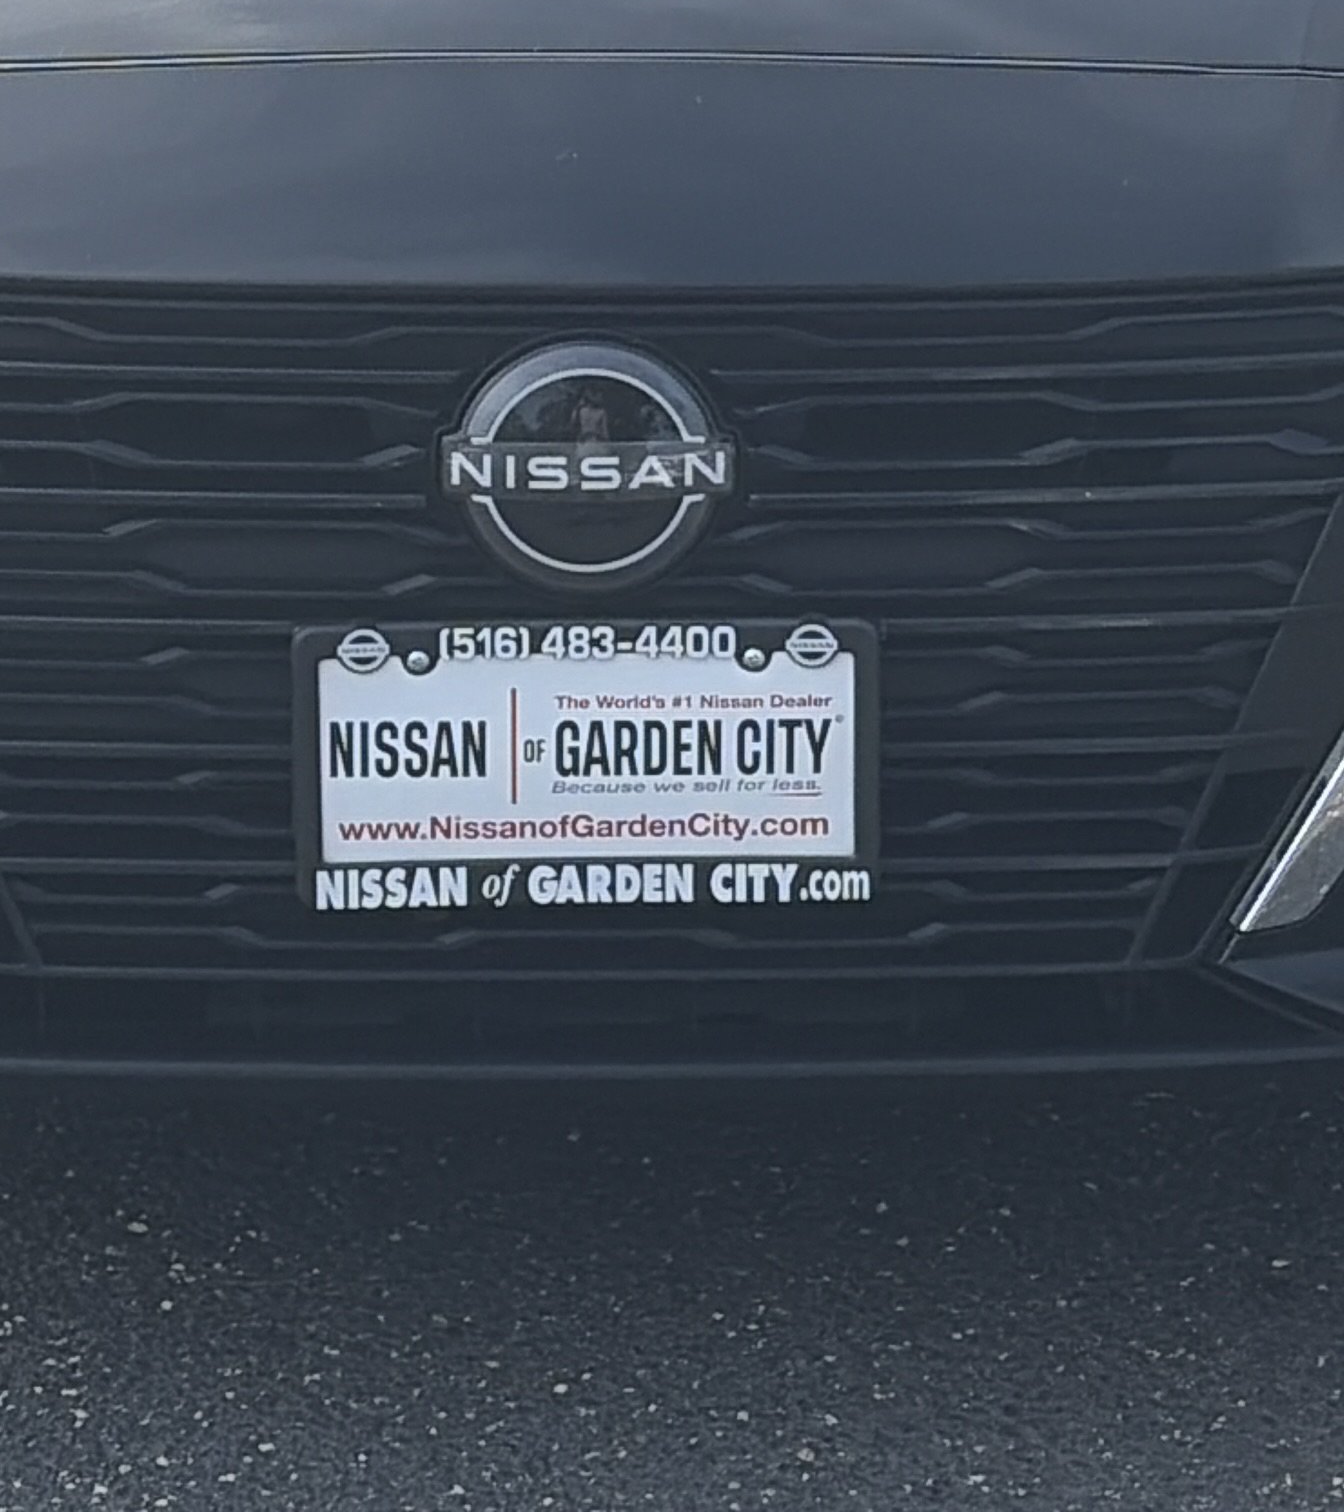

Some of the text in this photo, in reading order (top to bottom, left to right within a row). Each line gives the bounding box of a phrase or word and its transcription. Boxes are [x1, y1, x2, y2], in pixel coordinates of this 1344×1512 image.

[450, 451, 726, 490] NISSAN
[439, 626, 736, 660] (516) 483-4400
[555, 694, 833, 710] The World's #1 Nissan Dealer
[329, 718, 831, 778] NISSAN OF GARDEN CITY
[552, 780, 646, 795] Because
[653, 782, 686, 794] we
[692, 779, 731, 793] sell
[736, 779, 766, 792] for
[338, 814, 830, 842] www.NissanofGardenCity.com
[315, 862, 871, 910] NISSAN of GARDEN CITY.com
